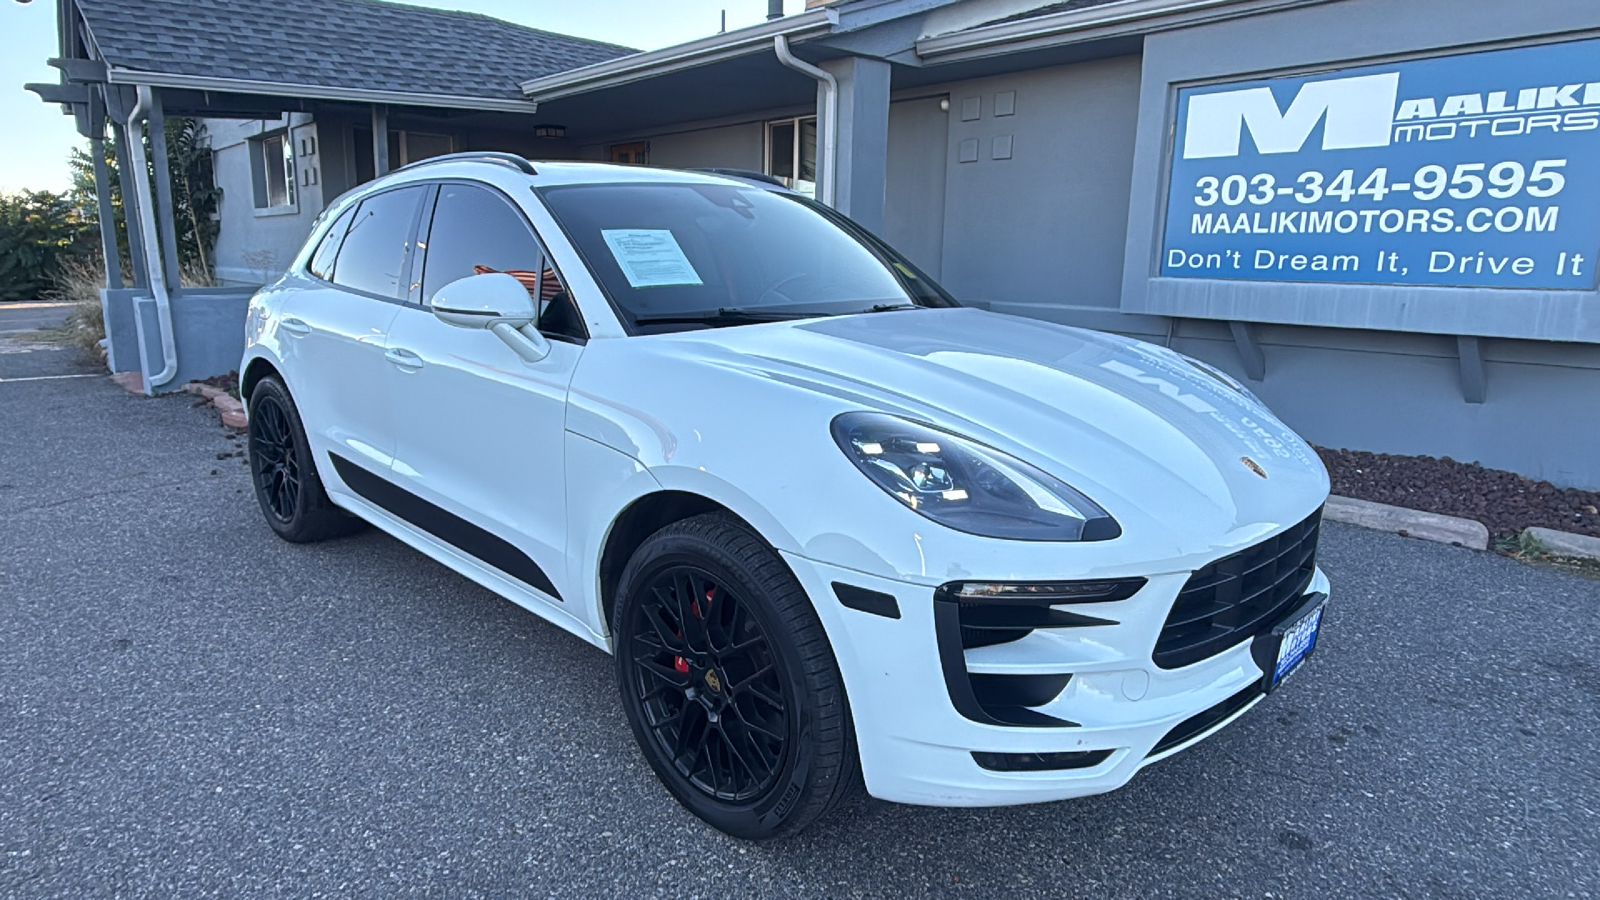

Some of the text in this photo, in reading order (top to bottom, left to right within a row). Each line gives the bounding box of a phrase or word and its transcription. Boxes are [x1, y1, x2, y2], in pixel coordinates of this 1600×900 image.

[1394, 112, 1600, 143] MOTORS
[1194, 159, 1567, 207] 303-344-9595
[1191, 206, 1559, 234] MAALIKIMOTORS.COM
[1167, 249, 1584, 276] Don't Dream It, Drive It
